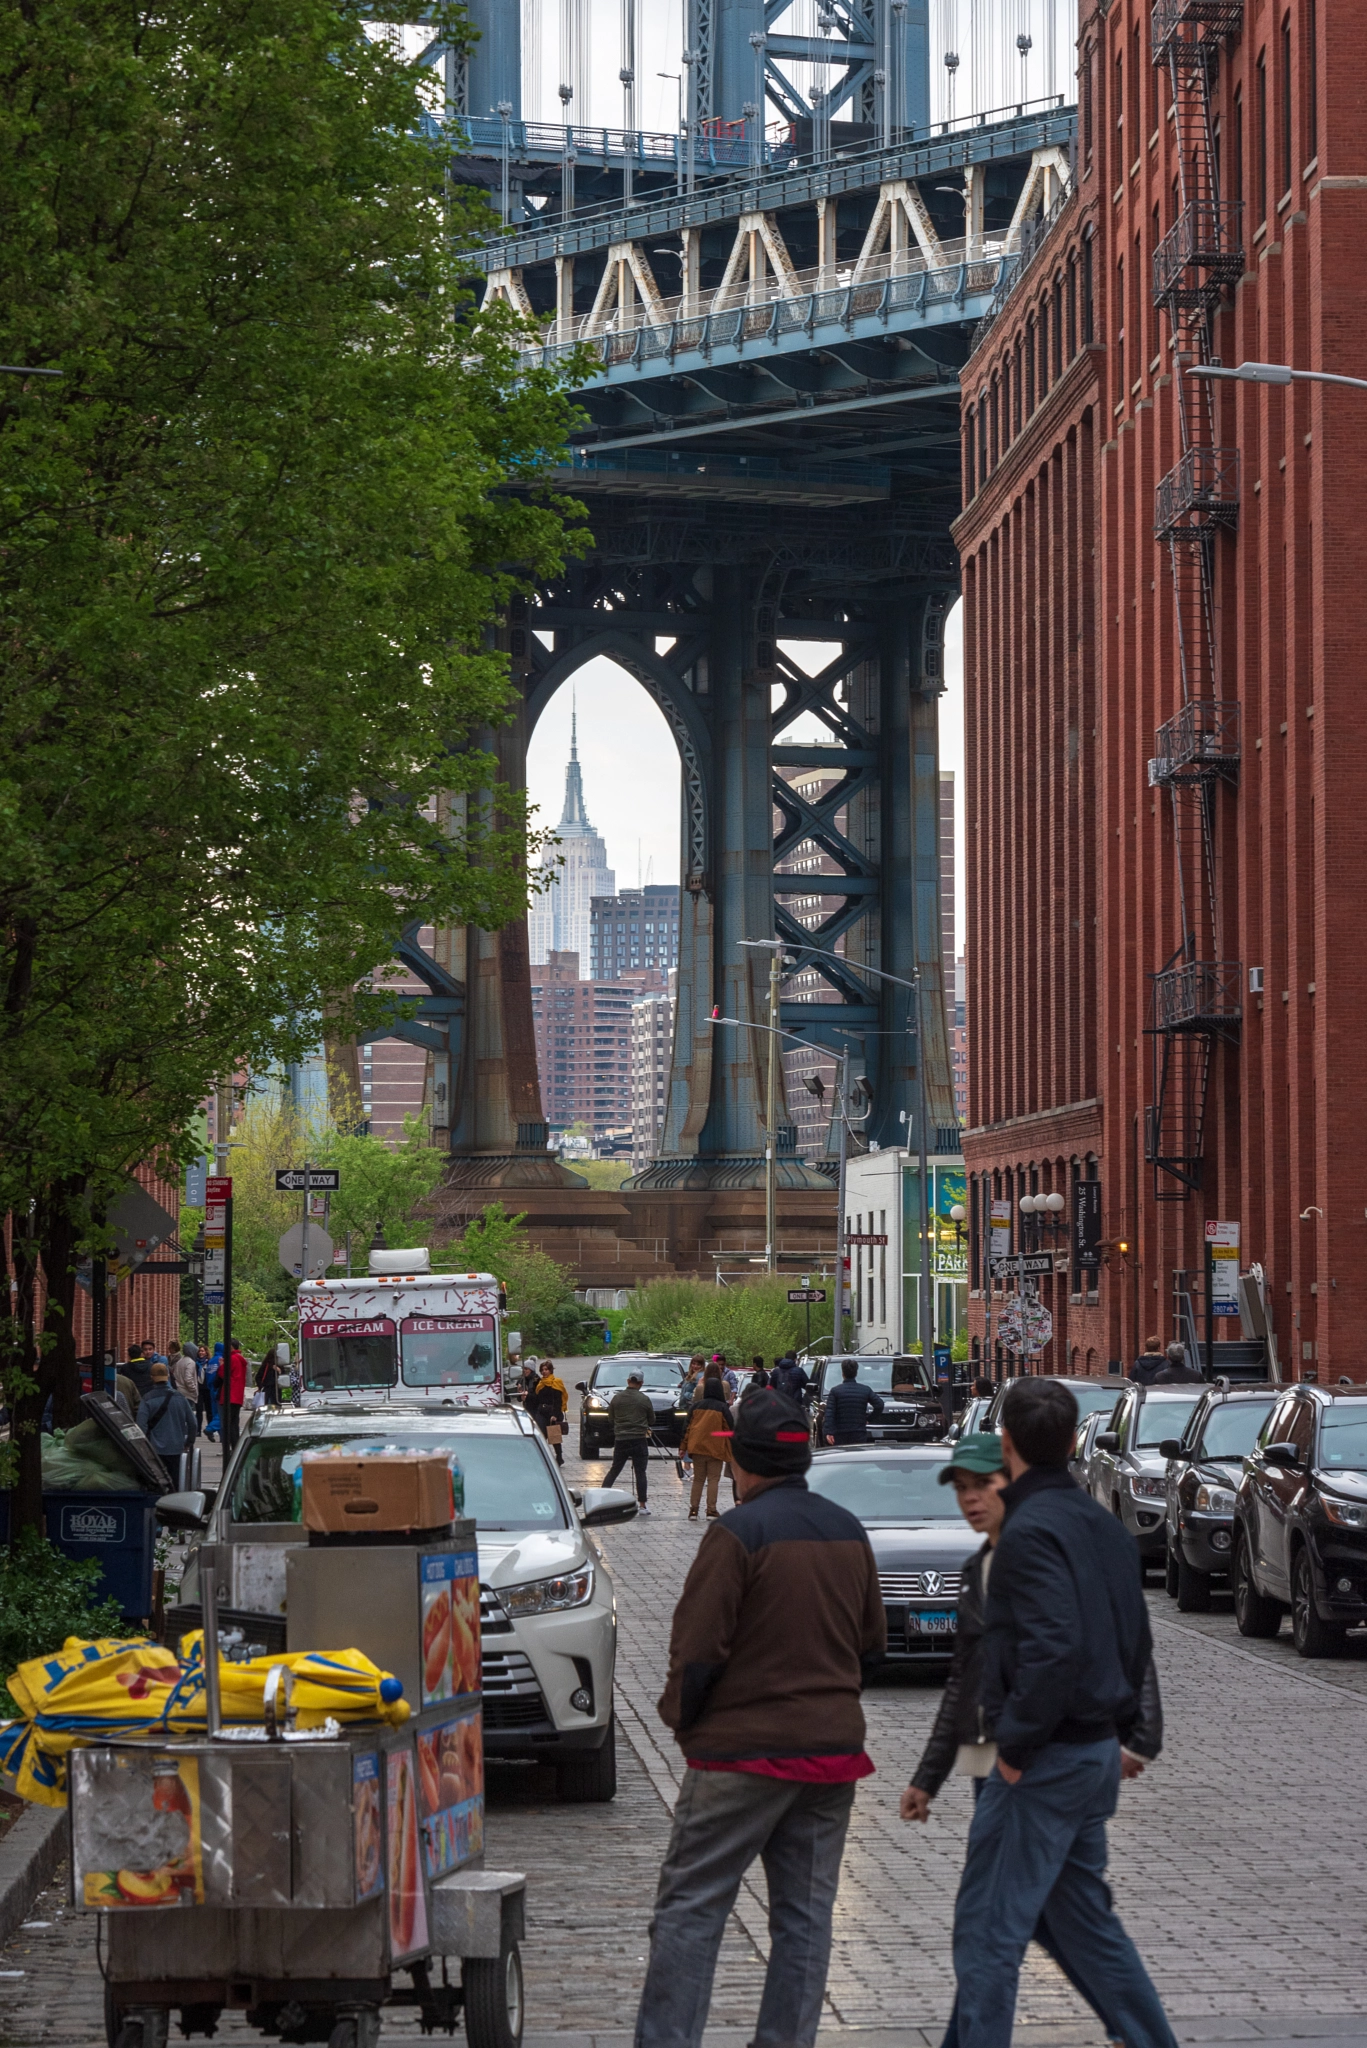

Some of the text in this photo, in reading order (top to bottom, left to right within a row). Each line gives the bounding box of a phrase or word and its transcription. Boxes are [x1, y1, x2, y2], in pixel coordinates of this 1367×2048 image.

[285, 1176, 331, 1185] ONE WAY
[1076, 1186, 1087, 1249] 25 Washington St.
[847, 1236, 886, 1245] Plymouth St
[206, 1248, 212, 1260] 2
[999, 1259, 1045, 1272] ONE WAY
[1212, 1305, 1227, 1313] 2807
[313, 1322, 384, 1335] ICE CREAM
[413, 1318, 484, 1331] ICE CREAM
[70, 1514, 117, 1527] ROYAL
[928, 1617, 958, 1630] 69816
